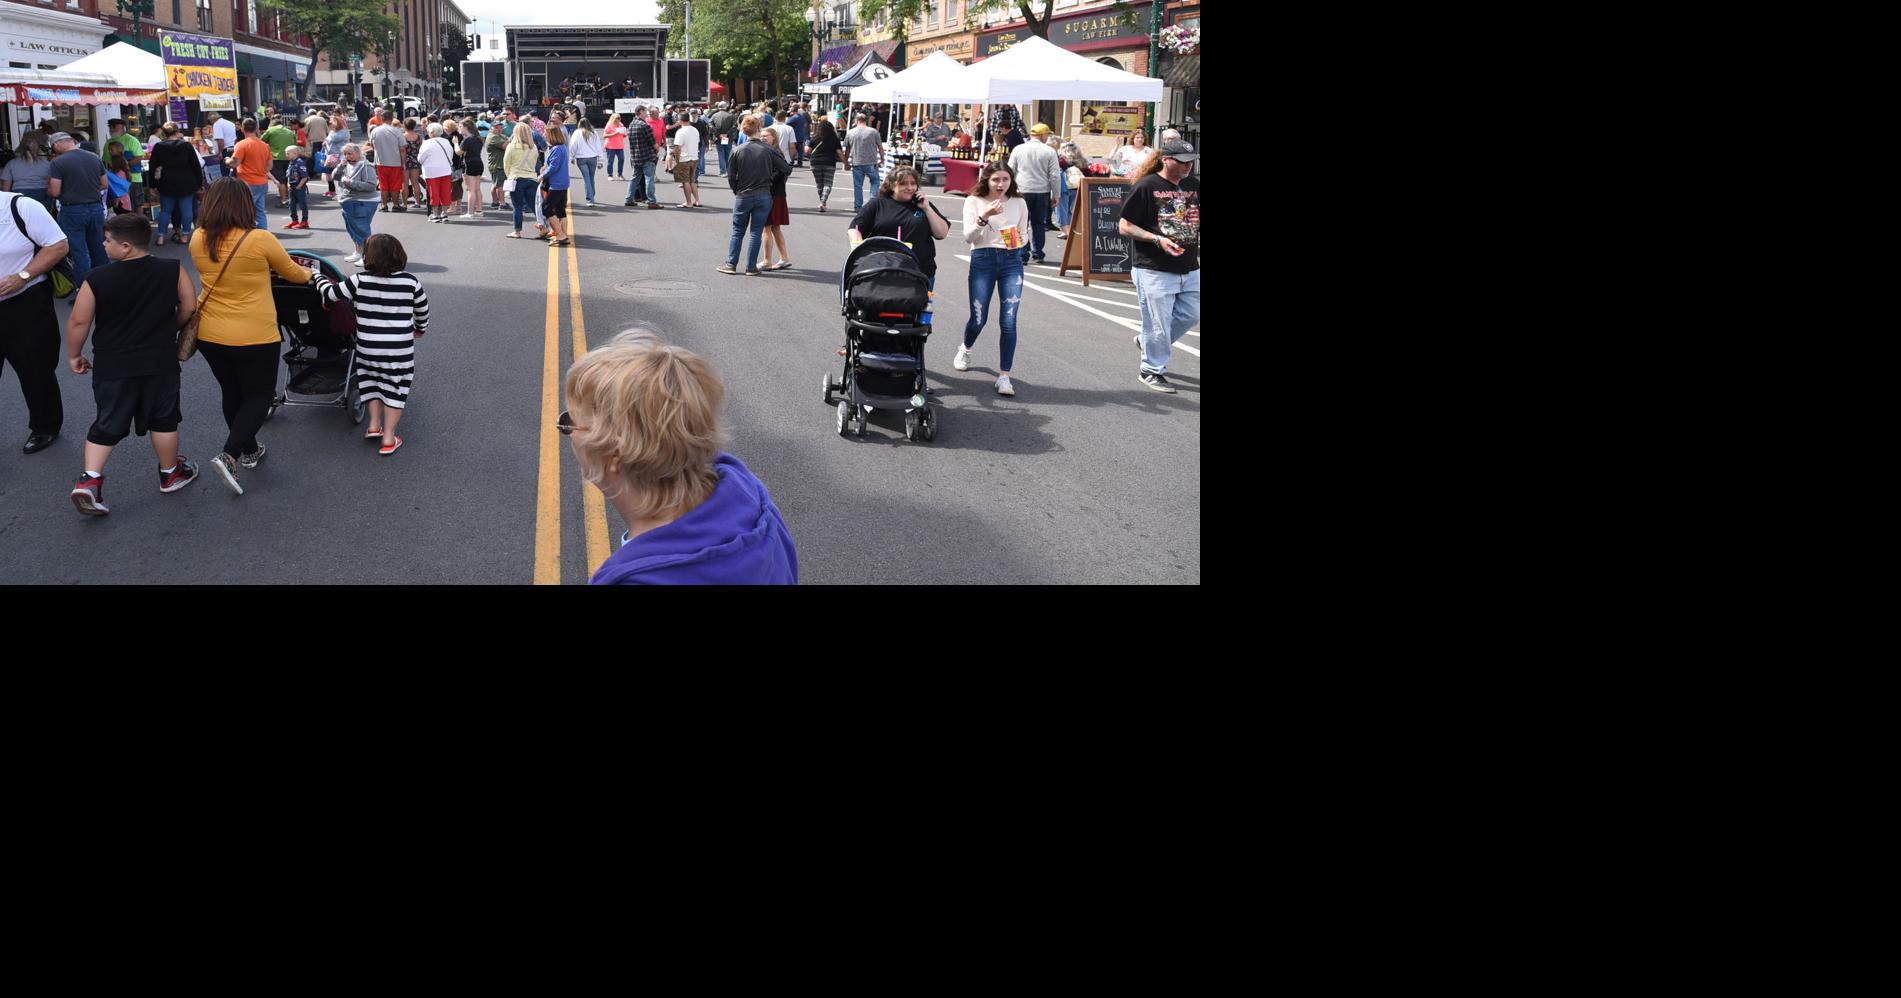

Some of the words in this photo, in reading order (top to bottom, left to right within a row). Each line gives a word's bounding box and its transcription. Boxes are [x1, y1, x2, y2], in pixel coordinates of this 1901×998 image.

[1065, 12, 1140, 34] SUGARMN
[1082, 31, 1096, 40] LAW
[1098, 29, 1118, 38] FIRM
[20, 42, 45, 51] LAW
[49, 45, 88, 56] OFFICES
[171, 42, 195, 58] FRESH
[197, 44, 209, 59] CUT
[211, 46, 229, 60] FRIES
[186, 71, 212, 88] CHICKEN
[838, 86, 854, 94] PRI
